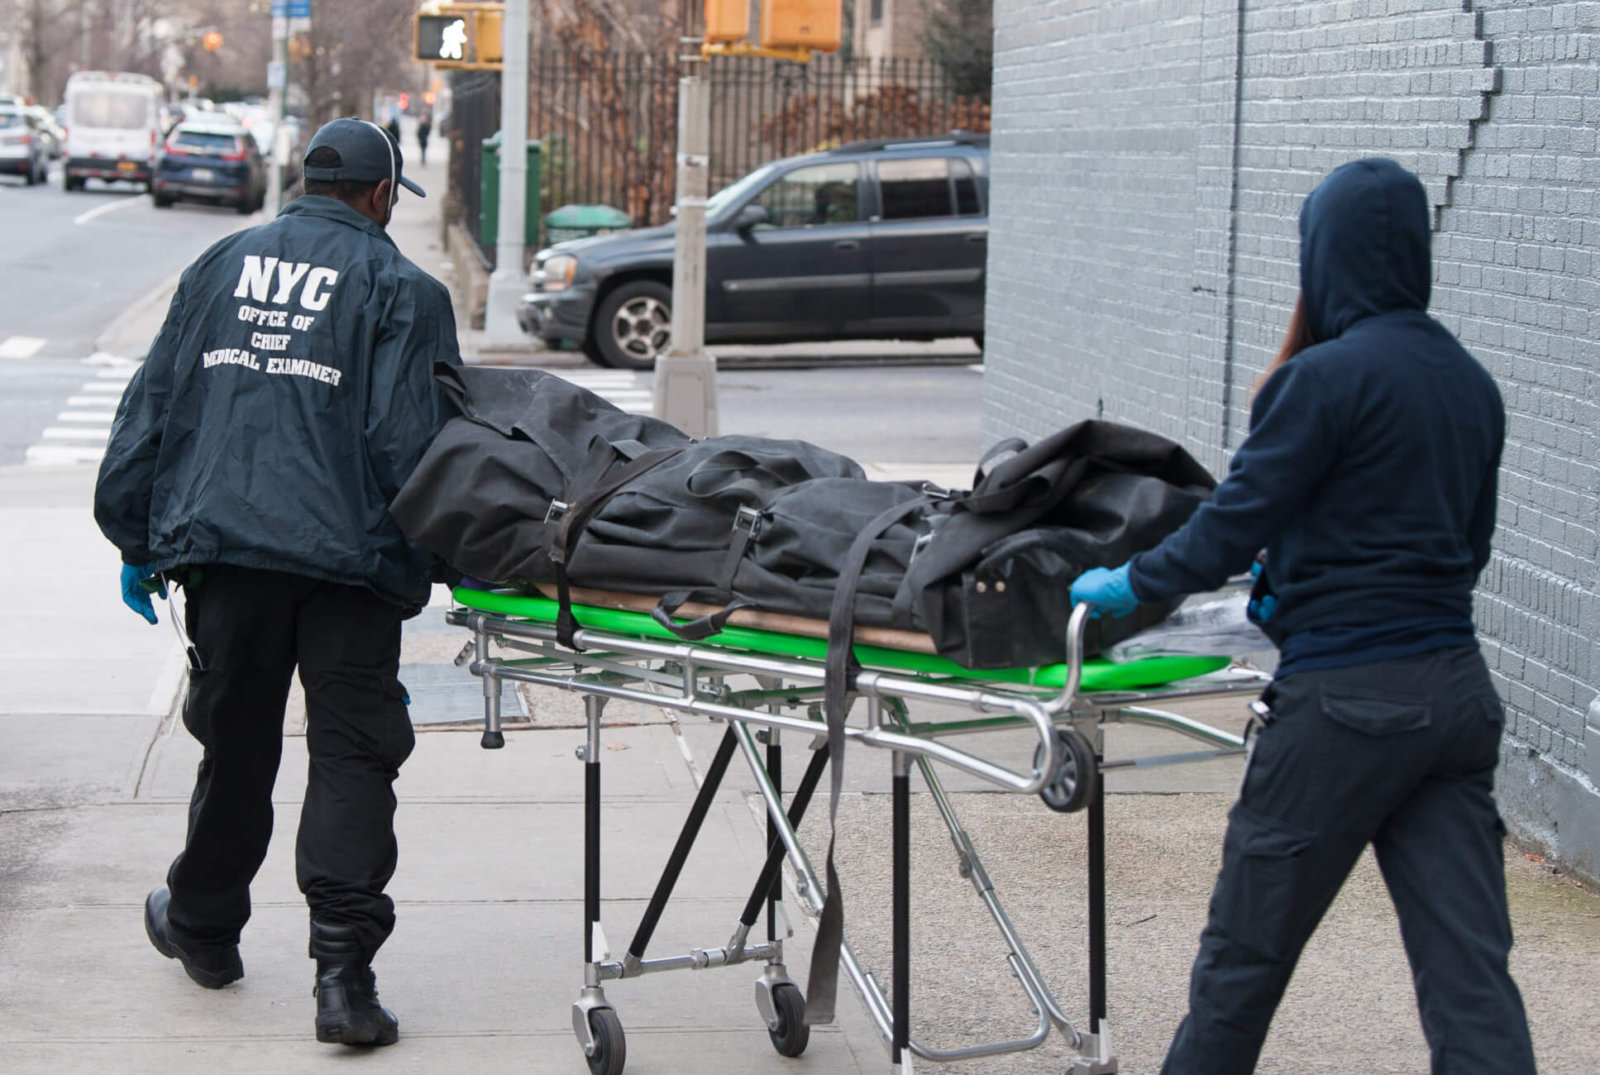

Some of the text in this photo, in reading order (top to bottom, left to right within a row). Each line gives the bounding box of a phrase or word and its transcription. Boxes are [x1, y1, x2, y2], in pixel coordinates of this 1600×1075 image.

[233, 255, 339, 311] NYC
[238, 305, 315, 331] OFFCE OF
[250, 331, 291, 350] CHIEF
[203, 348, 342, 387] MEDICAL EXAMINER
